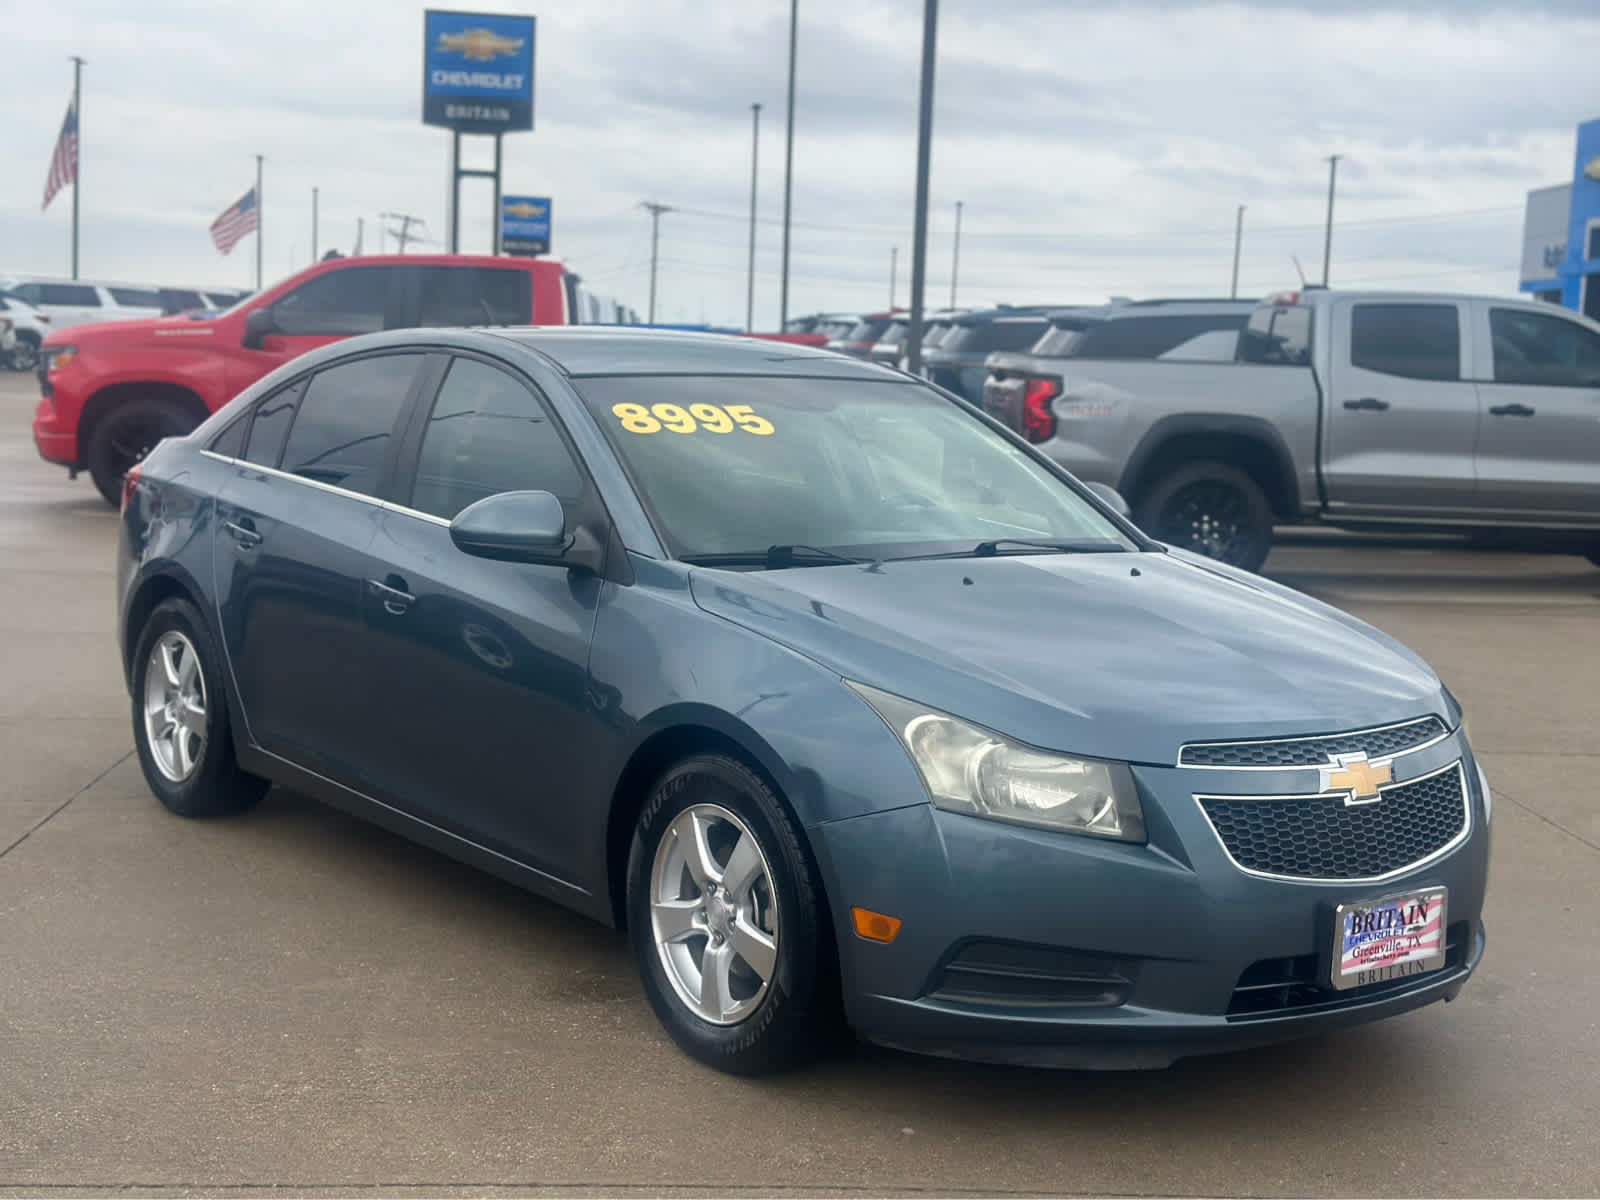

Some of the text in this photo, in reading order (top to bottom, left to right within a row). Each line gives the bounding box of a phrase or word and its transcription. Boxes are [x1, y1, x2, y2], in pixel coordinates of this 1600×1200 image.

[431, 70, 525, 89] CHEVROLET
[445, 104, 511, 121] BRITAIN
[612, 403, 775, 436] 8995
[1351, 903, 1429, 936] BRITAIN
[1349, 928, 1405, 946] CHEVROLET
[1407, 936, 1422, 949] TX
[1358, 960, 1425, 985] BRITAIN
